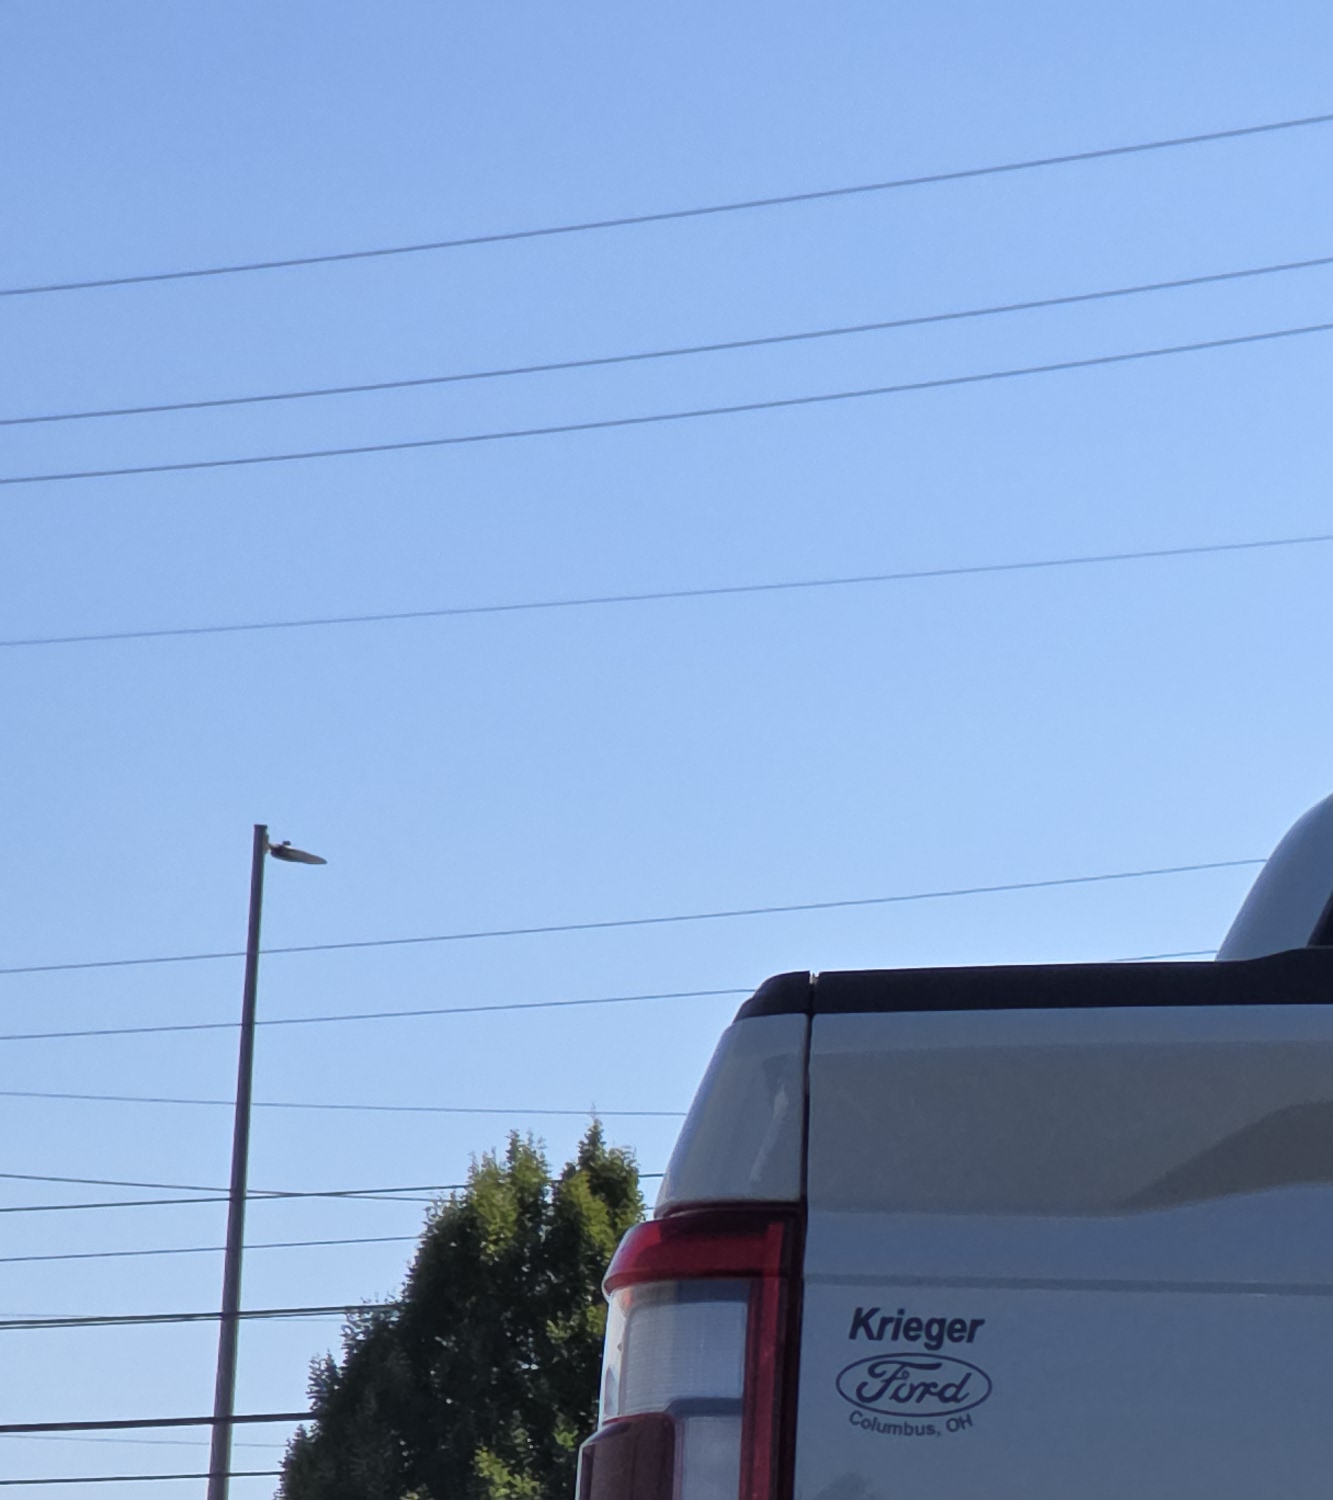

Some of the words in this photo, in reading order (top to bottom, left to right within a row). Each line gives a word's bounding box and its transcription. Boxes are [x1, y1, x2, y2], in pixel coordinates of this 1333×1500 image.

[849, 1307, 985, 1351] Krieger
[856, 1360, 972, 1403] Ford
[849, 1410, 941, 1437] Columbus,
[946, 1414, 973, 1432] OH
